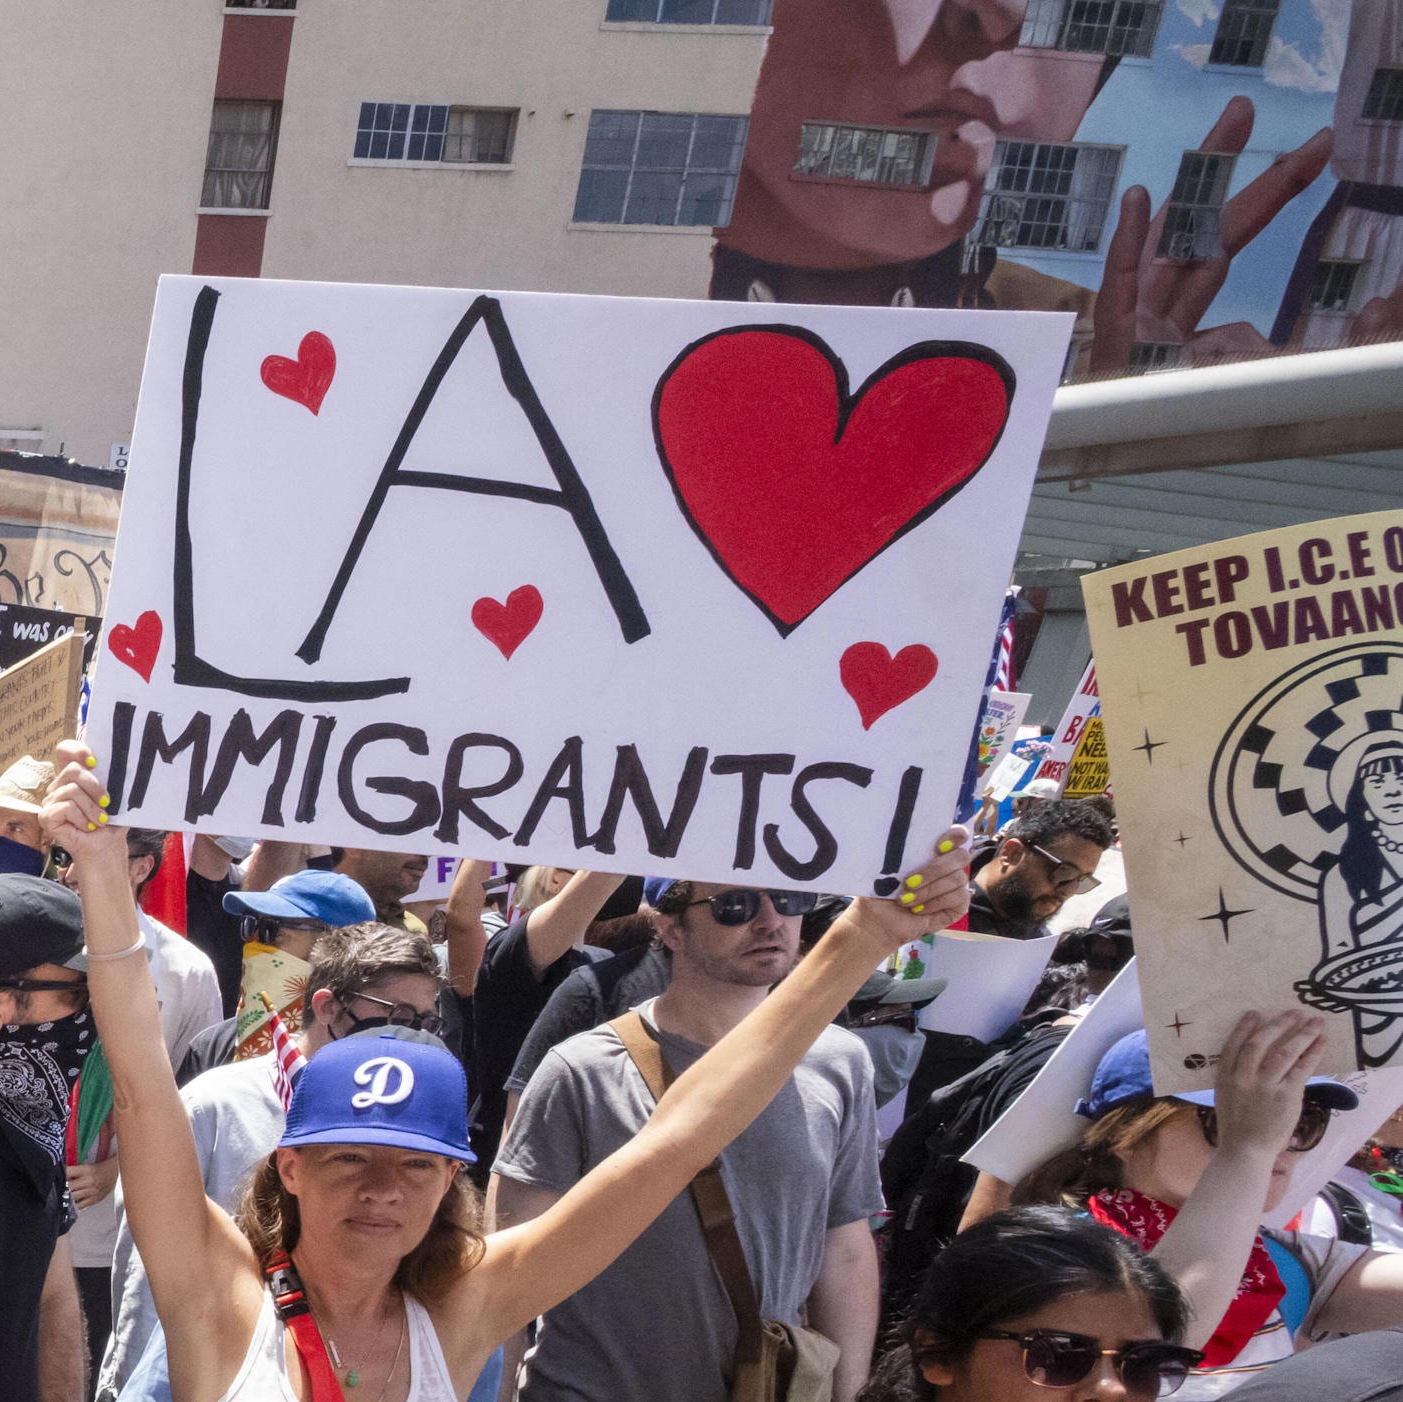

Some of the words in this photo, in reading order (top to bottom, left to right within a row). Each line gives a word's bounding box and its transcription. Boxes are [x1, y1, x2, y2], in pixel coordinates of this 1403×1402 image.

[174, 285, 652, 701] LA
[1111, 554, 1251, 629] KEEP
[12, 621, 51, 643] was
[1070, 761, 1096, 776] NOT
[1078, 742, 1108, 758] NEE
[107, 701, 924, 897] IMMIGRANTS!
[351, 1055, 415, 1109] D
